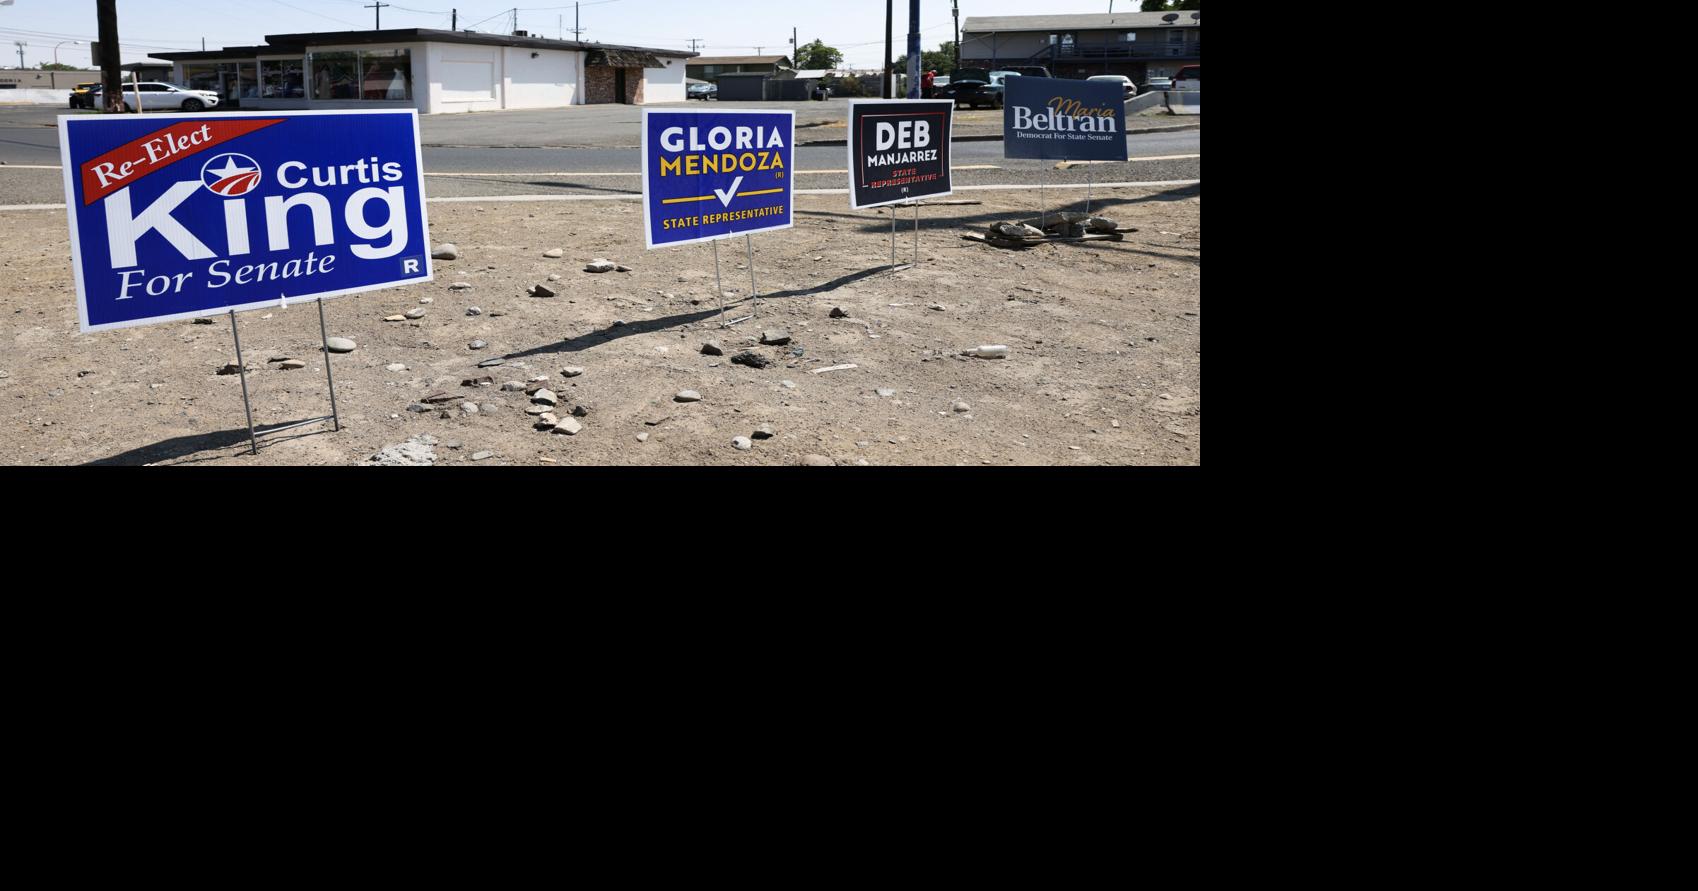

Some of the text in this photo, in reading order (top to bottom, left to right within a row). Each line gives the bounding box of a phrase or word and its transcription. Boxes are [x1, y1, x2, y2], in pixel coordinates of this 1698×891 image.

[1012, 105, 1117, 133] Beltran
[1048, 96, 1115, 120] Maria
[660, 126, 785, 152] GLORIA
[876, 120, 930, 151] DEB
[1016, 131, 1113, 141] Democrat For State Senate
[91, 123, 213, 189] Re-Elect
[660, 151, 784, 177] MENDOZA
[867, 149, 938, 168] MANJARREZ
[276, 156, 403, 189] Curtis
[871, 173, 937, 189] REPRESENTATIVE
[892, 168, 917, 177] STATE
[104, 180, 408, 269] King
[663, 205, 784, 230] STATE REPRESENTATIVE
[115, 251, 335, 301] For Senate
[403, 258, 420, 275] R
